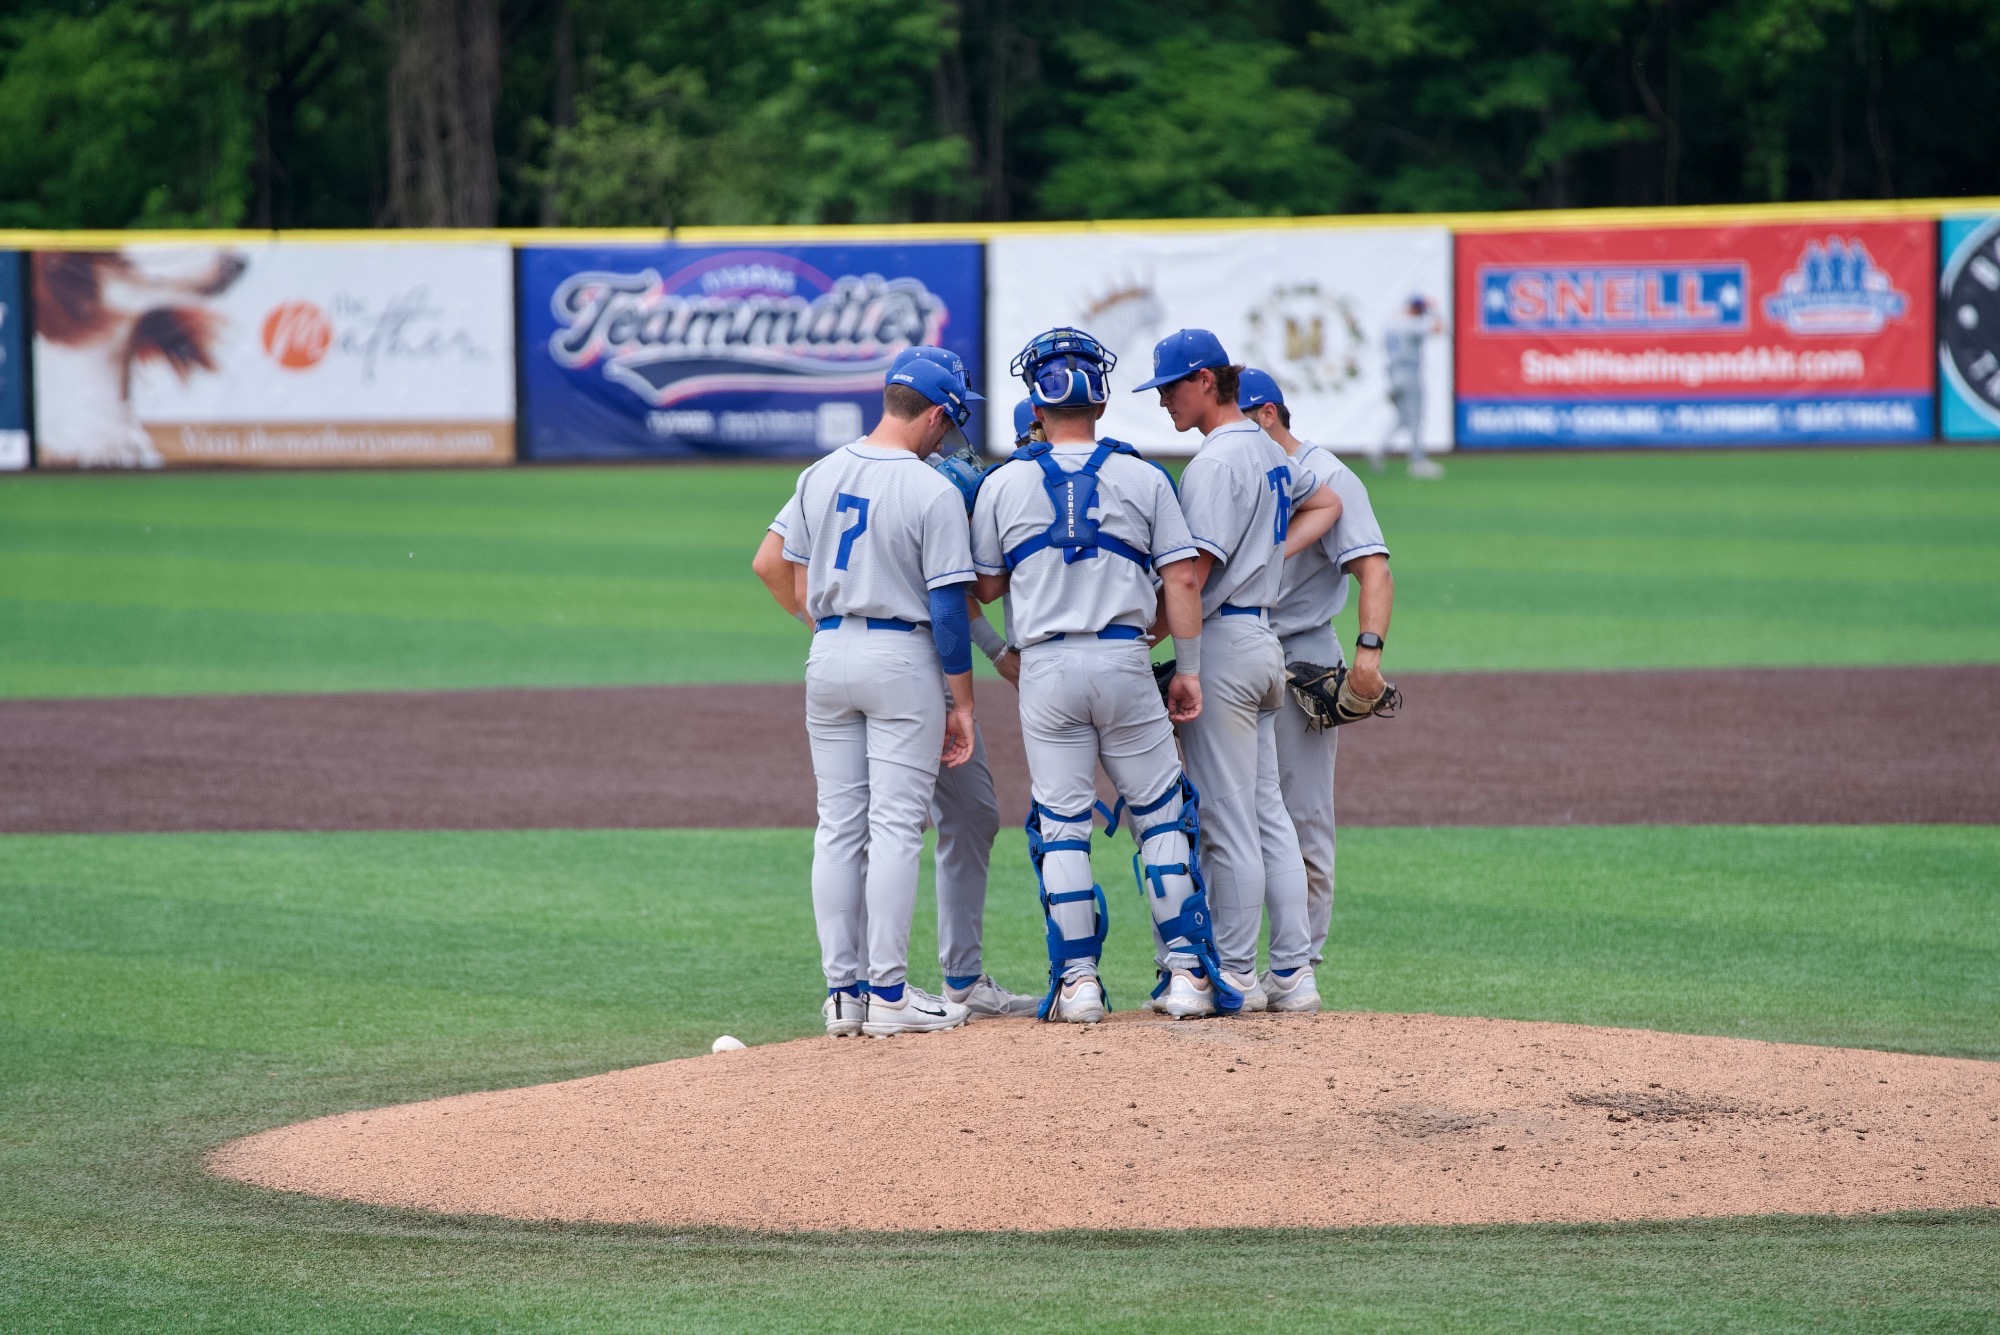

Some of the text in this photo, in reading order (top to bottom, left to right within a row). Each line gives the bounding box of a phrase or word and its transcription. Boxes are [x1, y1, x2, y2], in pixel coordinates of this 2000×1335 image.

[1508, 271, 1720, 323] SNELL
[1522, 346, 1863, 387] SnellHeatingandAir.com
[834, 493, 870, 571] 7
